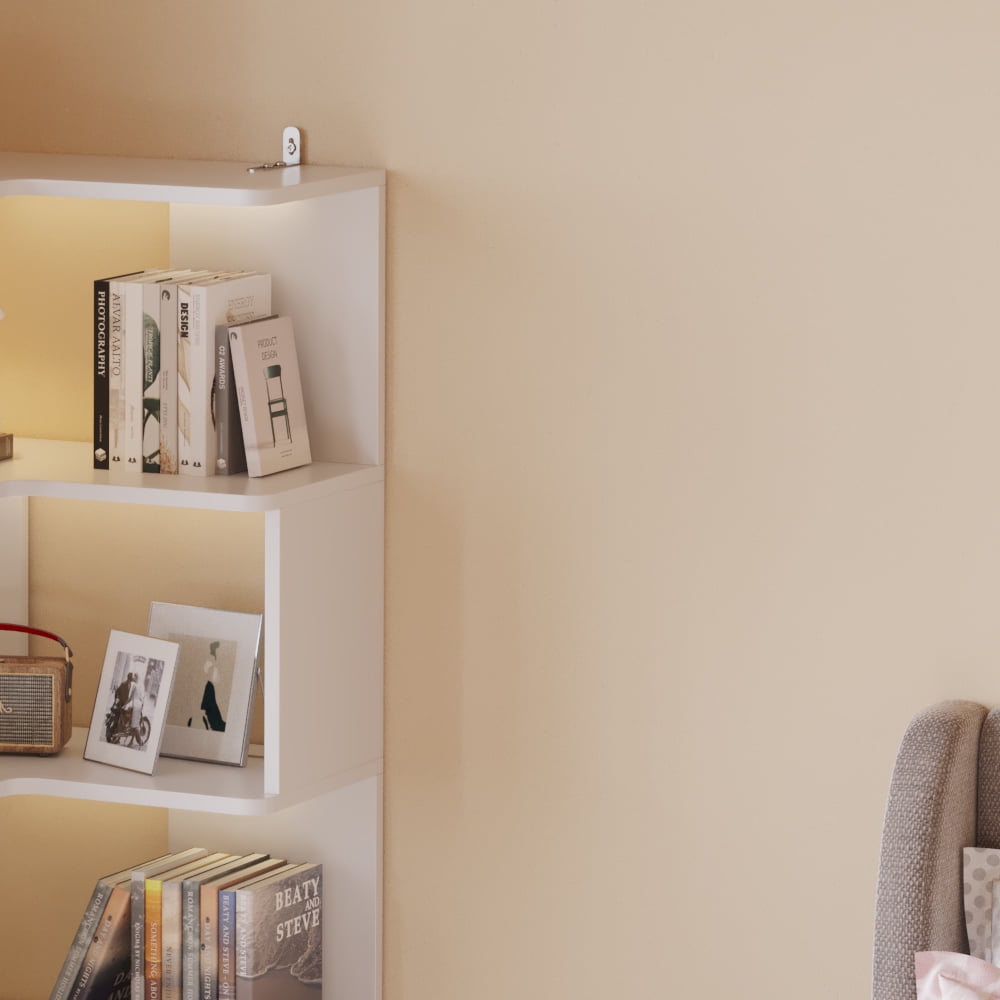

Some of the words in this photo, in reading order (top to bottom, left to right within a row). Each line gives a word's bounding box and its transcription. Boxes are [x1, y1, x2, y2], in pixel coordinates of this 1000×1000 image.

[111, 293, 121, 332] ALVAR
[180, 302, 189, 339] DESIGN
[97, 290, 106, 378] PHOTOGRAPHY
[111, 333, 121, 376] AALTO
[218, 357, 226, 390] AWARDS
[222, 895, 230, 922] BEATY
[275, 876, 320, 912] BEATY
[305, 896, 320, 910] AND
[100, 921, 112, 940] DAY
[222, 925, 230, 945] AND
[239, 927, 248, 948] AND
[276, 909, 320, 942] STEVE
[149, 922, 158, 976] SOMETHING
[165, 947, 173, 975] NEVER
[222, 947, 230, 974] STEVE
[80, 957, 96, 989] NIGHTS
[113, 970, 132, 986] DA
[203, 967, 212, 1000] NIGHTS
[222, 982, 230, 994] ON
